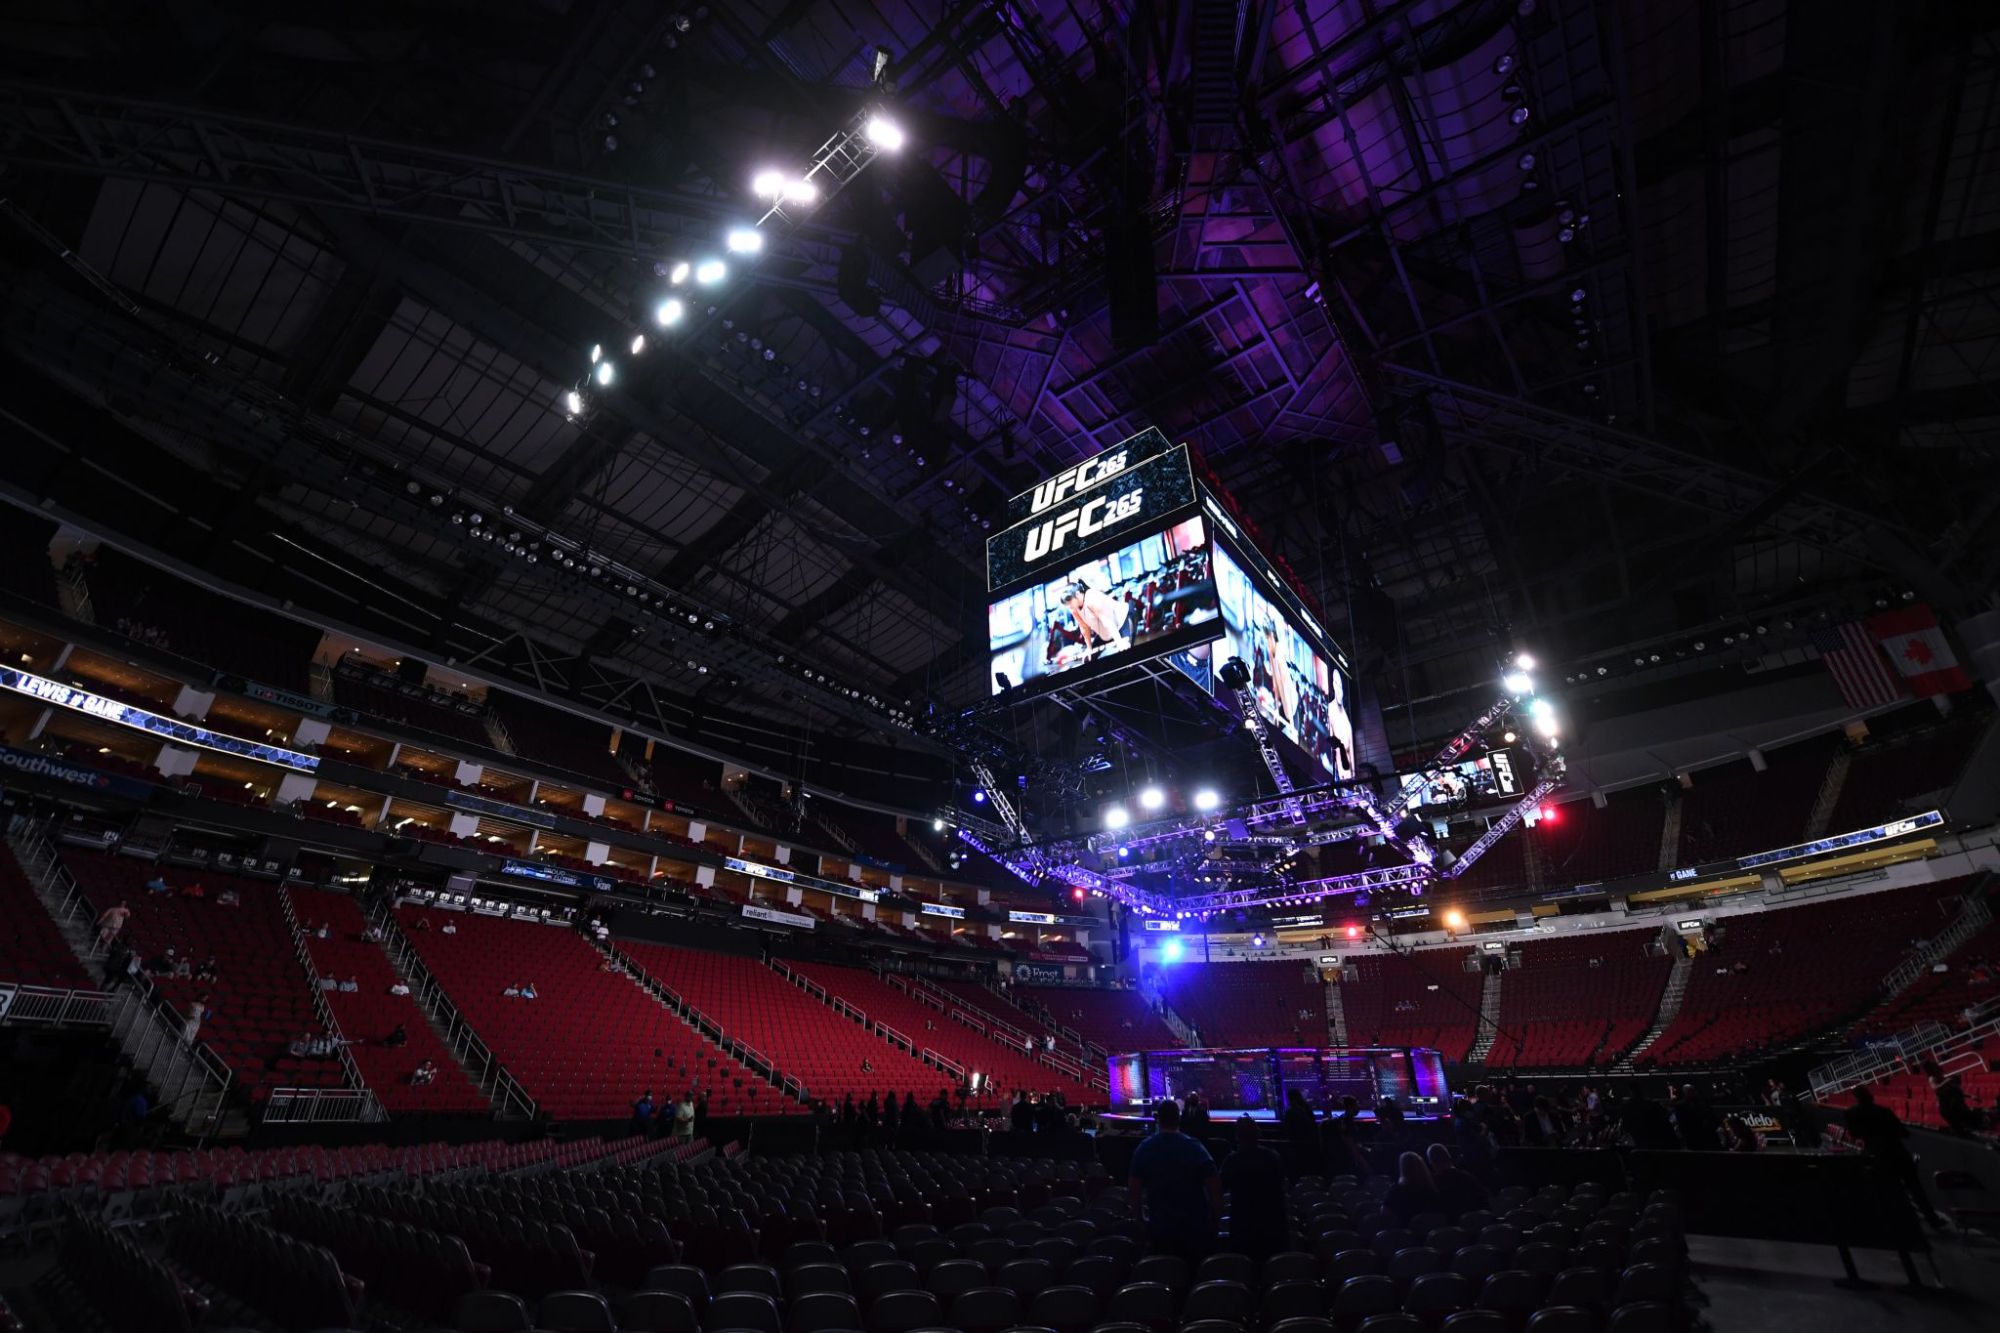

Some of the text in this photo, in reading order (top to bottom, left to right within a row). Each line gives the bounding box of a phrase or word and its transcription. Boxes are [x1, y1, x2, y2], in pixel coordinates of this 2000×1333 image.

[1031, 458, 1098, 513] UFC
[1024, 495, 1106, 562] UFC
[1103, 488, 1143, 527] 265
[17, 675, 71, 703] LEWIS
[83, 696, 125, 720] GANE
[275, 693, 324, 712] TISSOT
[1676, 868, 1698, 880] GANE
[746, 908, 768, 919] reliant
[1033, 967, 1059, 979] Frost
